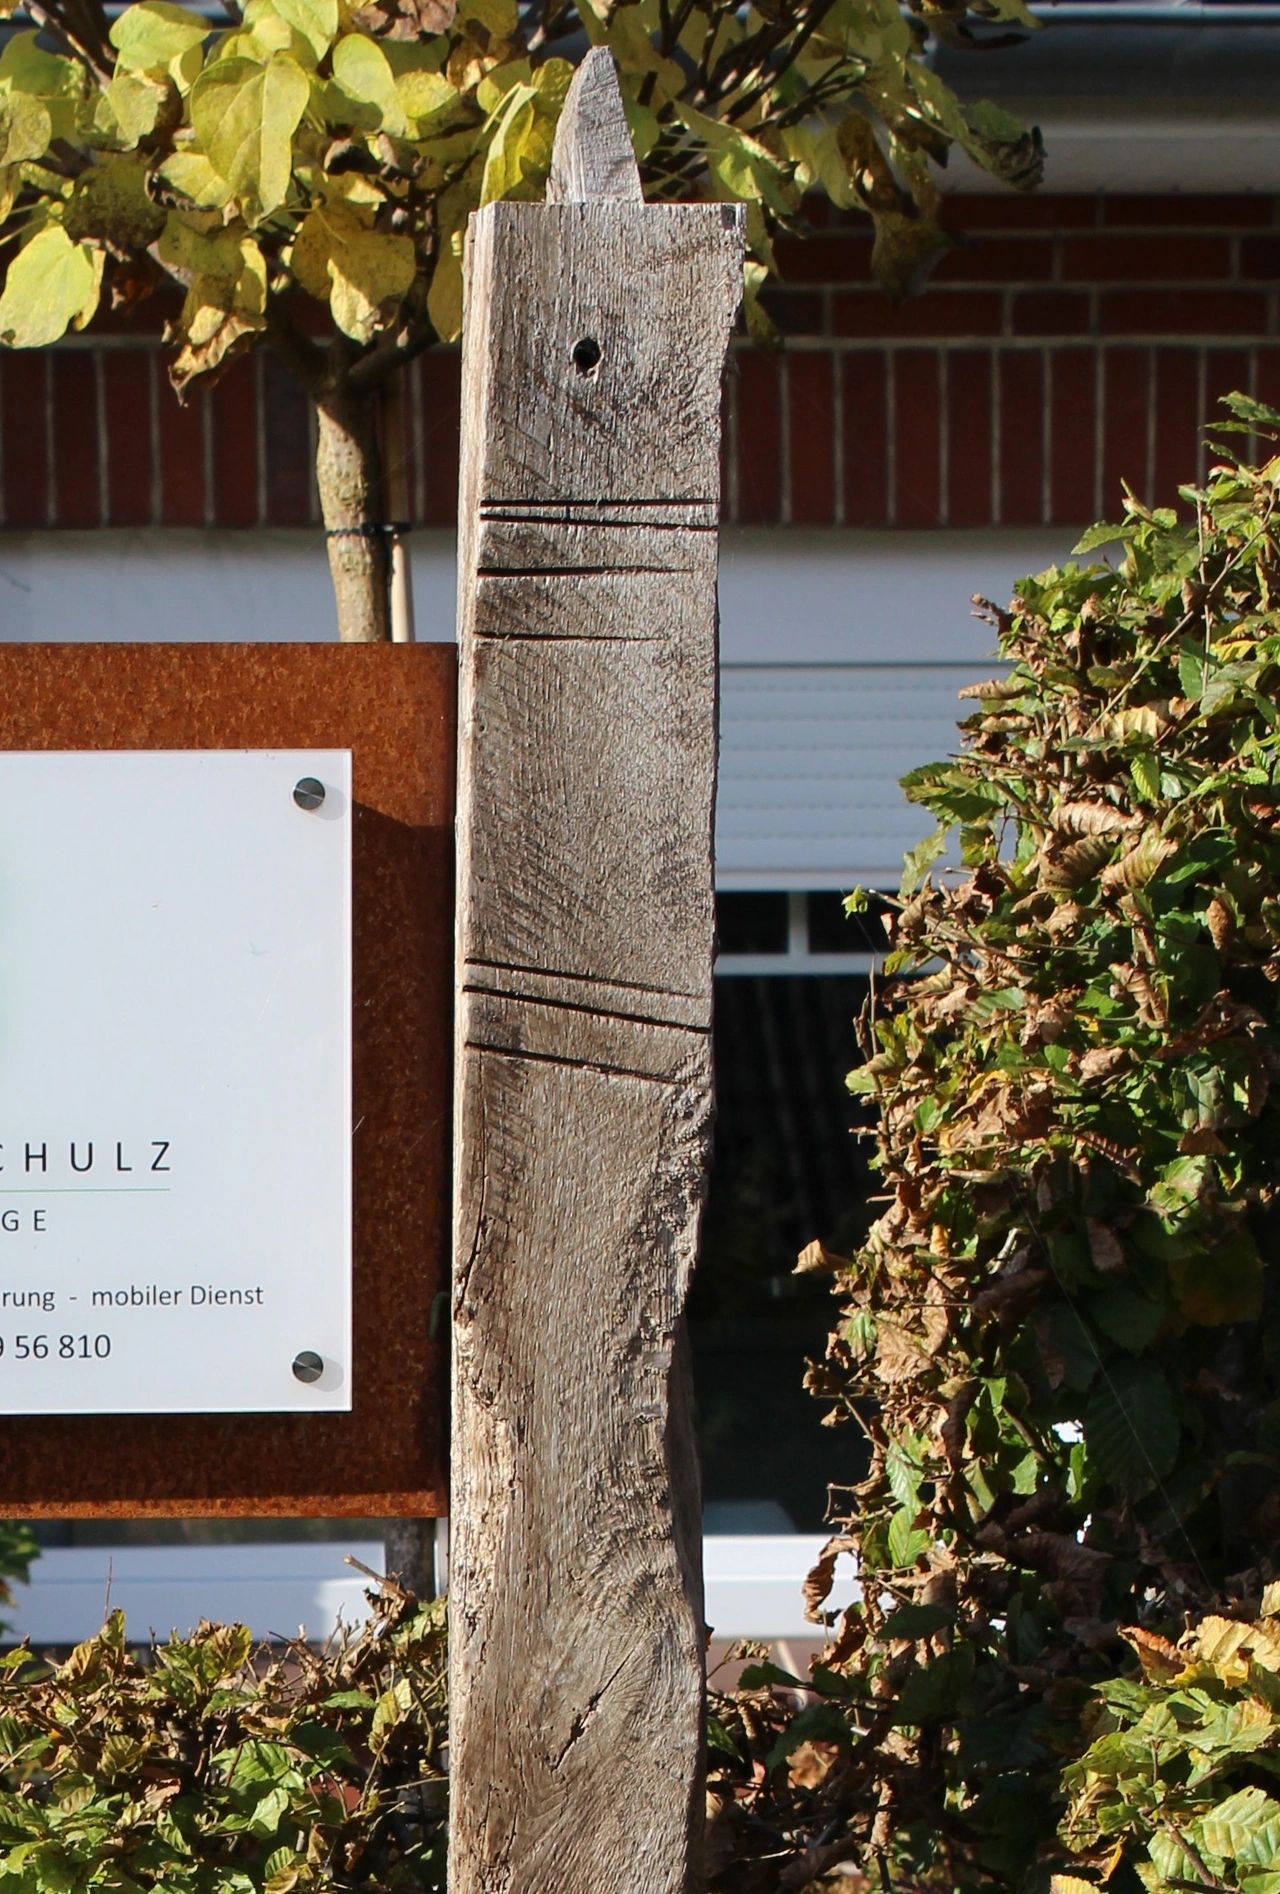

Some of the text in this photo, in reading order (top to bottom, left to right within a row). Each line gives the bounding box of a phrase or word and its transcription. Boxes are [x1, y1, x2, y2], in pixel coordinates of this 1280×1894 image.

[91, 1284, 184, 1307] mobiler
[190, 1284, 265, 1307] Dienst
[14, 1334, 49, 1360] 56
[58, 1333, 112, 1360] 810
